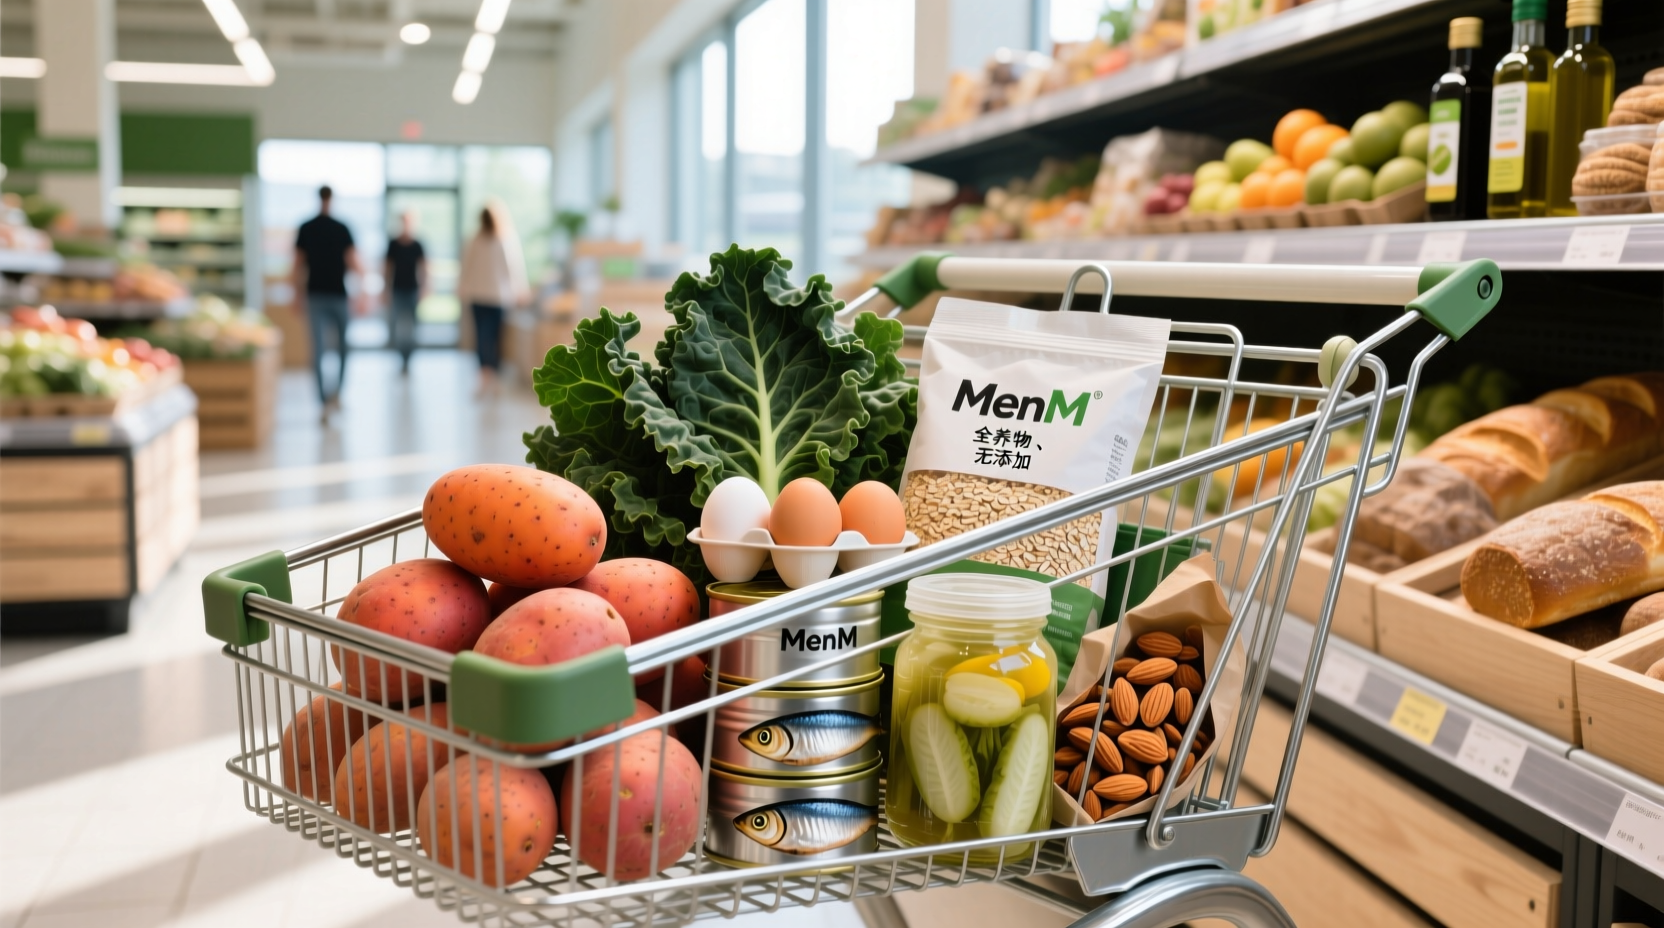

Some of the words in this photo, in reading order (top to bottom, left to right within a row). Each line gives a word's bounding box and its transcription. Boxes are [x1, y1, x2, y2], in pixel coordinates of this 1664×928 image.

[974, 447, 1031, 470] 无添加
[781, 626, 857, 651] MenM
